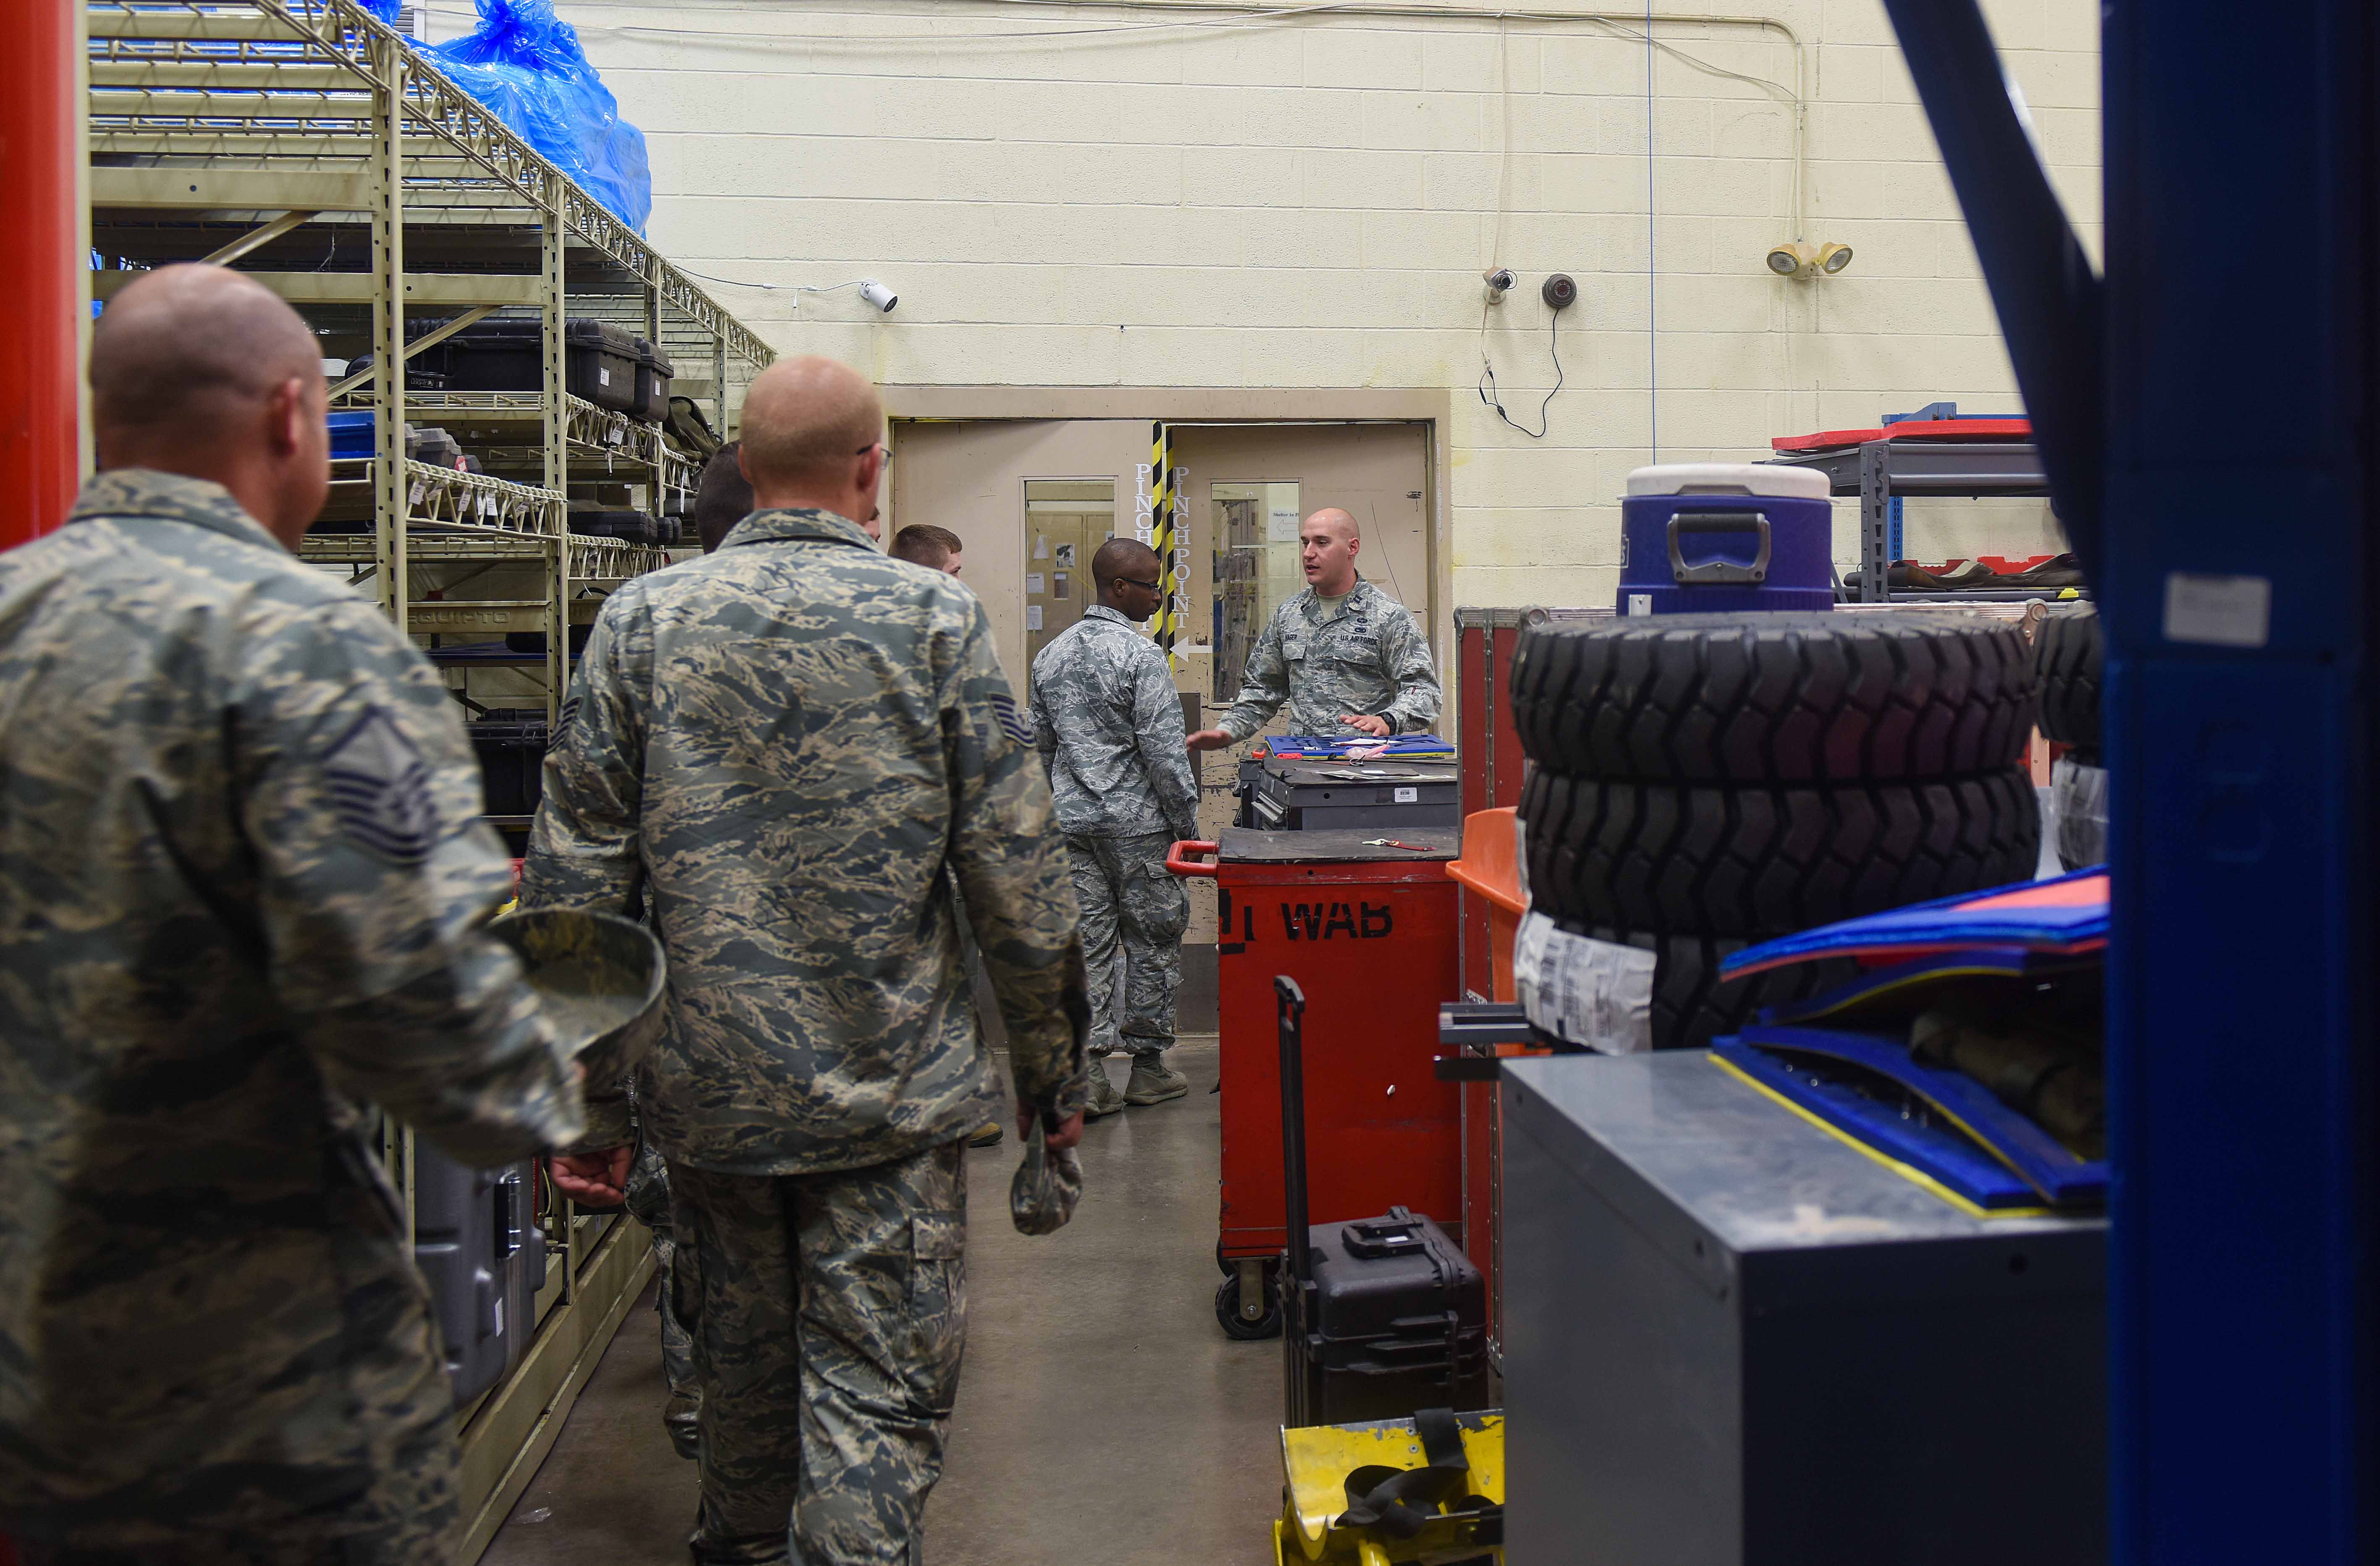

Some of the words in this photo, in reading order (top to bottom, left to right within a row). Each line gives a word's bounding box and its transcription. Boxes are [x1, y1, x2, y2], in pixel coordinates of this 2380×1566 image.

[1134, 464, 1153, 546] PINCH
[1172, 467, 1191, 545] PINCH
[1172, 548, 1191, 628] POINT
[1360, 636, 1378, 645] FORCE
